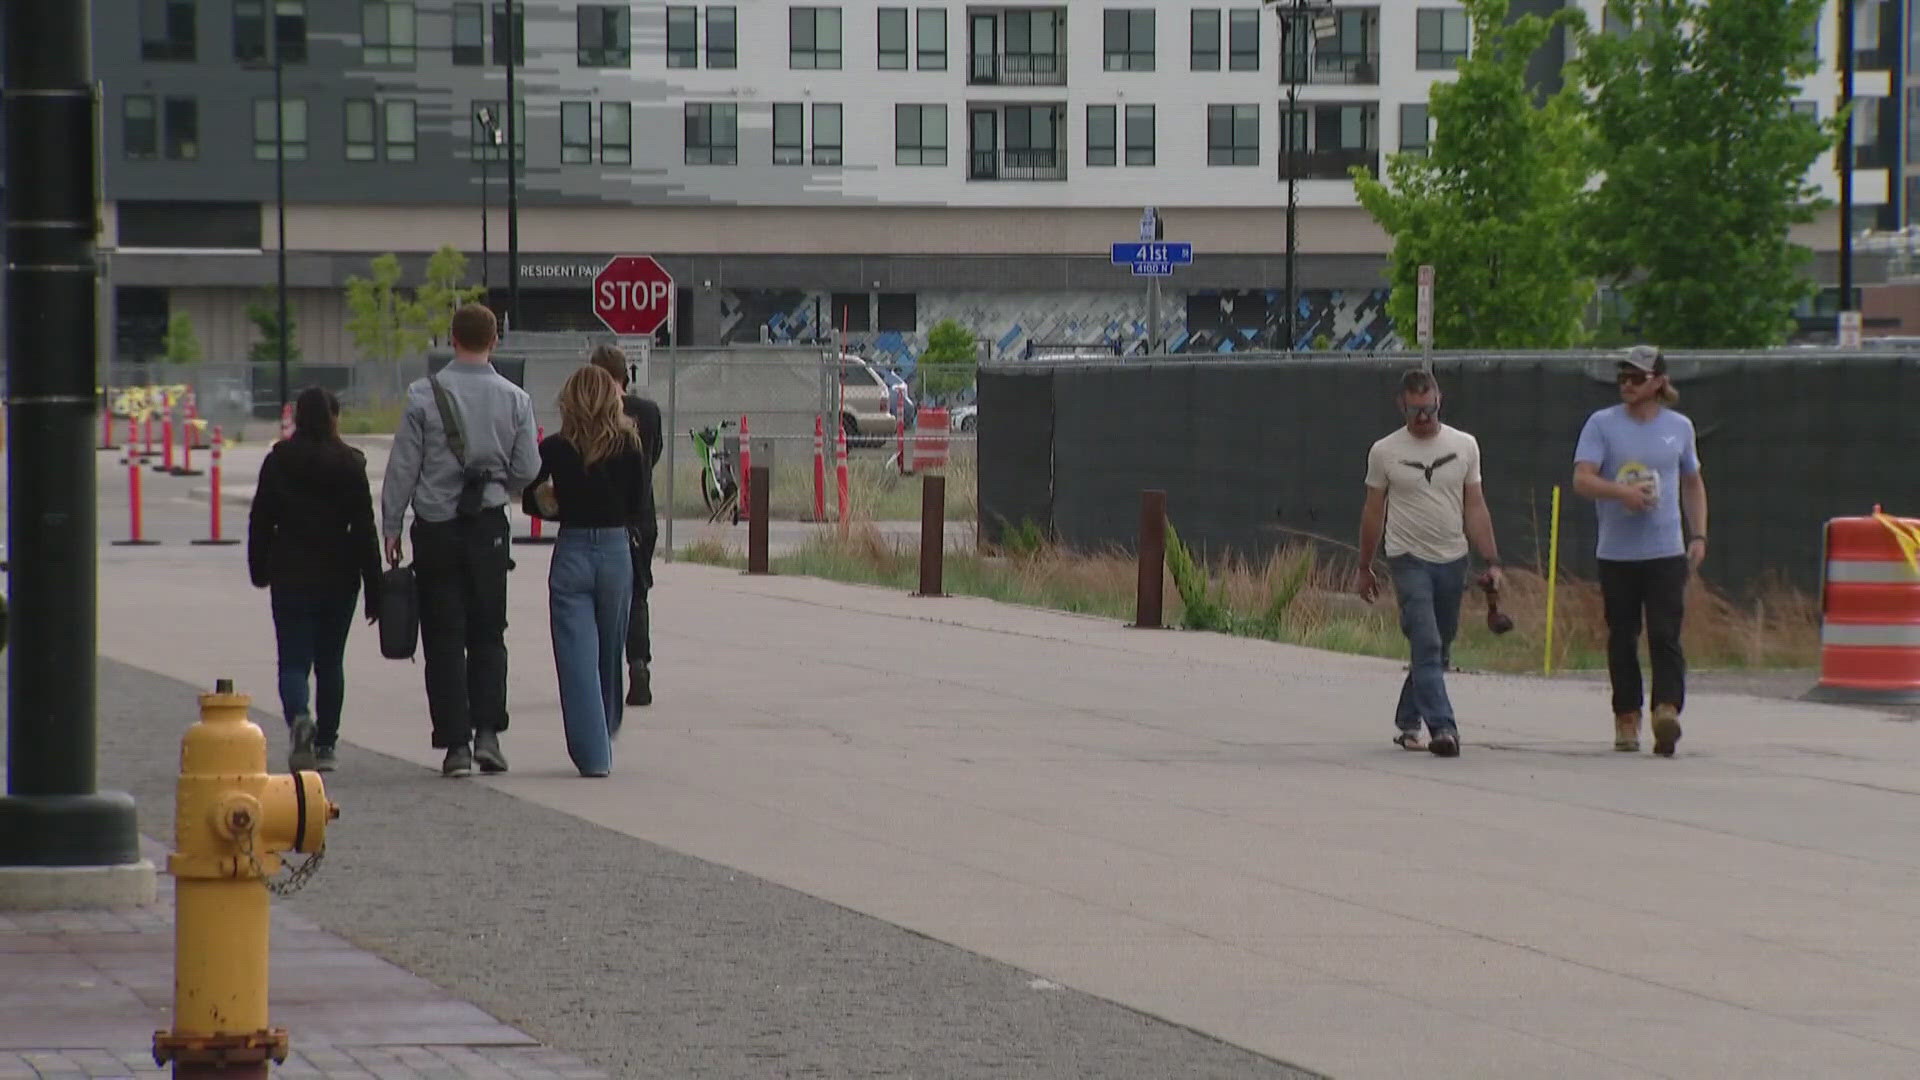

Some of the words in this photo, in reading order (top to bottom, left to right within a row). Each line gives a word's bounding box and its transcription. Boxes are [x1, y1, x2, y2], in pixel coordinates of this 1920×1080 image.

[1136, 244, 1168, 261] 41st
[520, 264, 576, 278] RESIDENT
[1136, 263, 1159, 273] 4100
[1161, 264, 1168, 273] N
[599, 280, 668, 311] STOP
